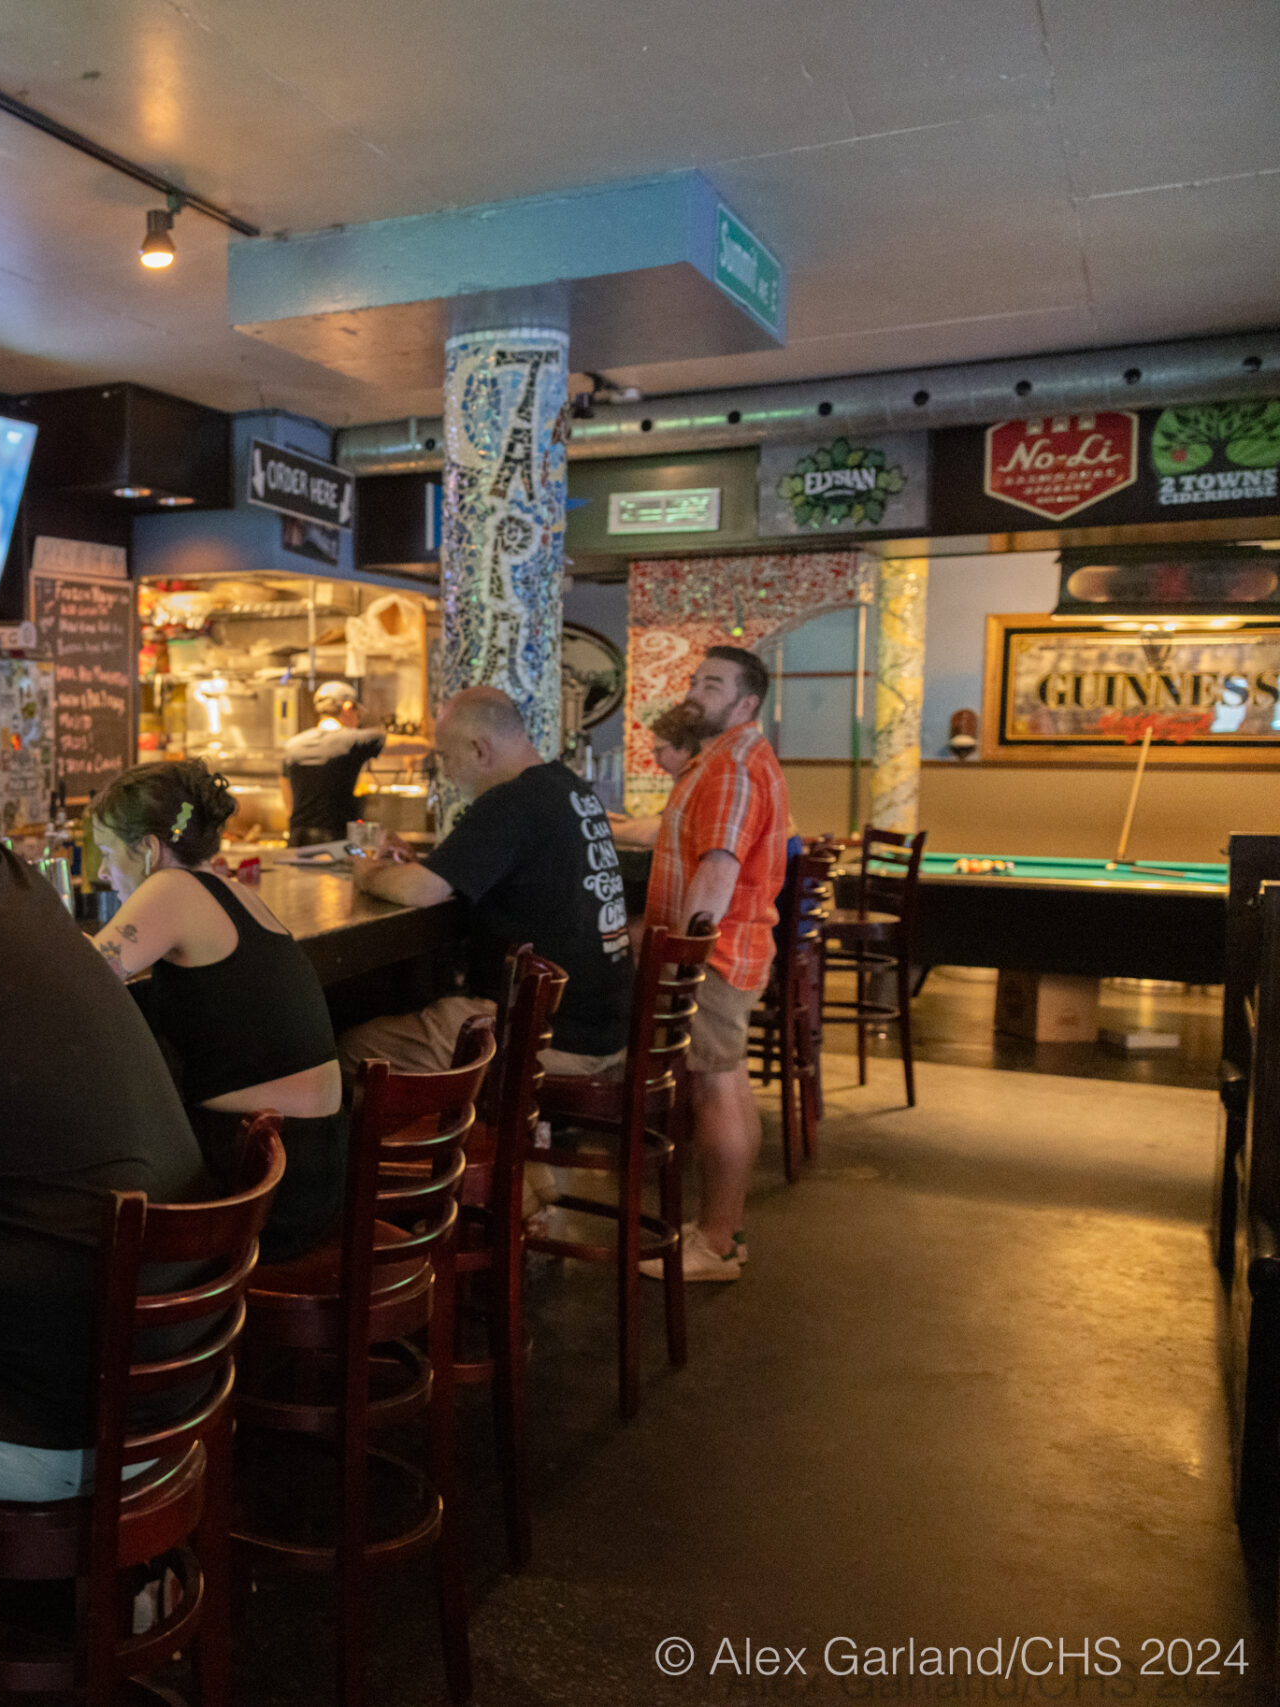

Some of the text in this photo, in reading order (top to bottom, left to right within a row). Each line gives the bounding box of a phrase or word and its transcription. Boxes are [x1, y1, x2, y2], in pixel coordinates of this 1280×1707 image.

[997, 433, 1123, 472] No-Li
[266, 459, 338, 509] ORDER HERE
[804, 467, 876, 495] ELYSIAN
[1160, 468, 1278, 493] 2 TOWNS
[1160, 486, 1278, 505] CIDERHOUSE
[1036, 671, 1280, 712] GUINNESS
